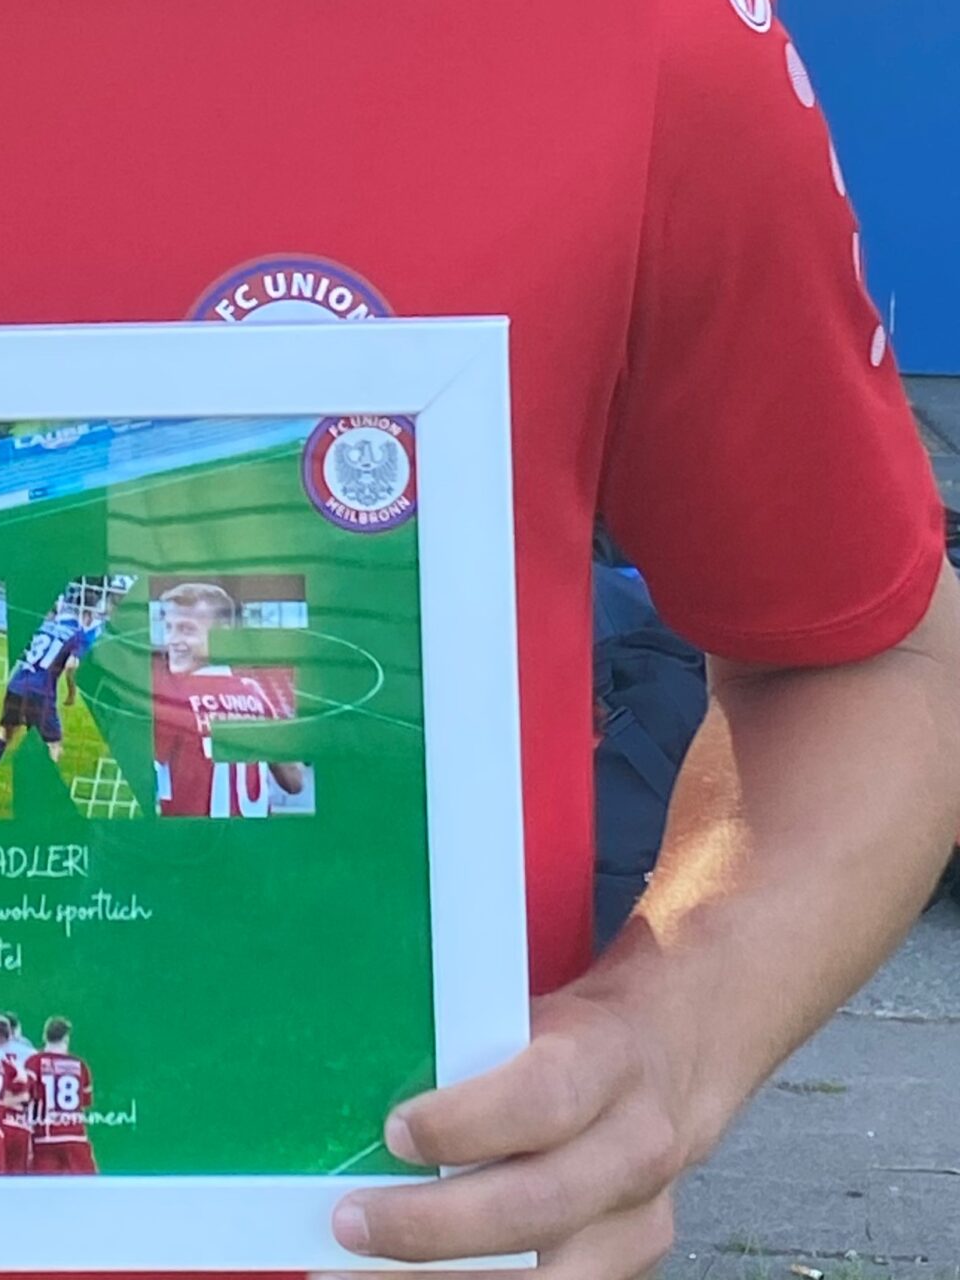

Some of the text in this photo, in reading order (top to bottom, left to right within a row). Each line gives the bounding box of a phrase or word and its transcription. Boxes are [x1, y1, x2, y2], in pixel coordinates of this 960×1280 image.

[214, 283, 259, 322] FC
[350, 415, 402, 436] UNION
[325, 494, 411, 525] HEILBRONN
[189, 694, 219, 712] FC
[55, 887, 153, 939] sportlich
[40, 1074, 81, 1111] 18
